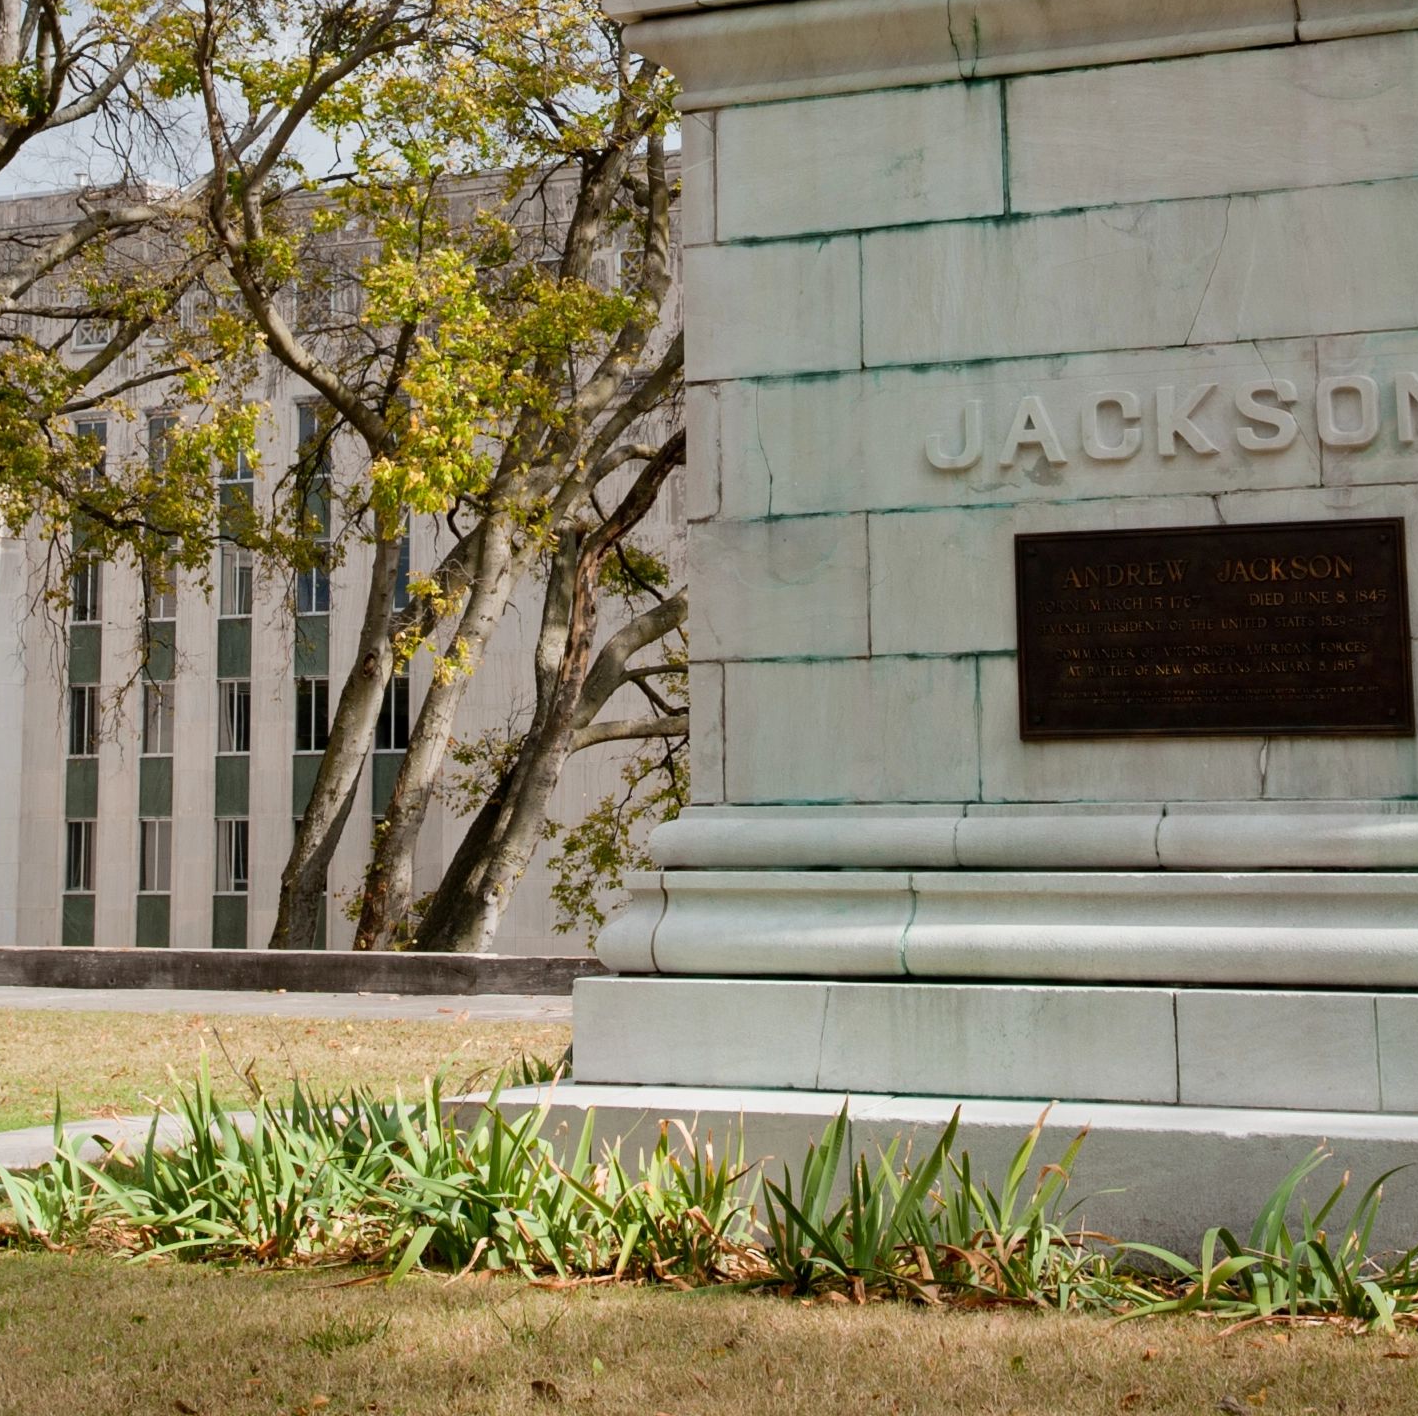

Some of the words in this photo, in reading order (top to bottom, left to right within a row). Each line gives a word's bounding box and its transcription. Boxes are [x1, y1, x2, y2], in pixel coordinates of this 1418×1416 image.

[1061, 560, 1190, 590] ANDREW
[1215, 555, 1355, 584] JACKSON
[1089, 597, 1142, 611] MARCH
[1170, 594, 1202, 608] 1767
[1249, 592, 1284, 606] DIED
[1291, 591, 1333, 604] JUNE
[1355, 589, 1387, 602] 1845
[1037, 622, 1090, 635] SEVENTH
[1098, 620, 1163, 633] PRESIDENT
[1169, 620, 1183, 631] OF
[1189, 618, 1213, 630] THE
[1221, 617, 1268, 630] UNITED
[1274, 616, 1315, 627] STATES
[1057, 647, 1135, 660] COMMANDER
[1141, 647, 1157, 658] OF
[1246, 643, 1312, 655] AMERICAN
[1317, 641, 1368, 653] FORCES
[1068, 665, 1081, 677] AT
[1088, 665, 1129, 677] BATTLE
[1135, 665, 1149, 676] OF
[1155, 664, 1182, 675] NEW
[1193, 662, 1251, 674] ORLEANS
[1256, 661, 1311, 673] JANUARY
[1333, 660, 1356, 671] 1815
